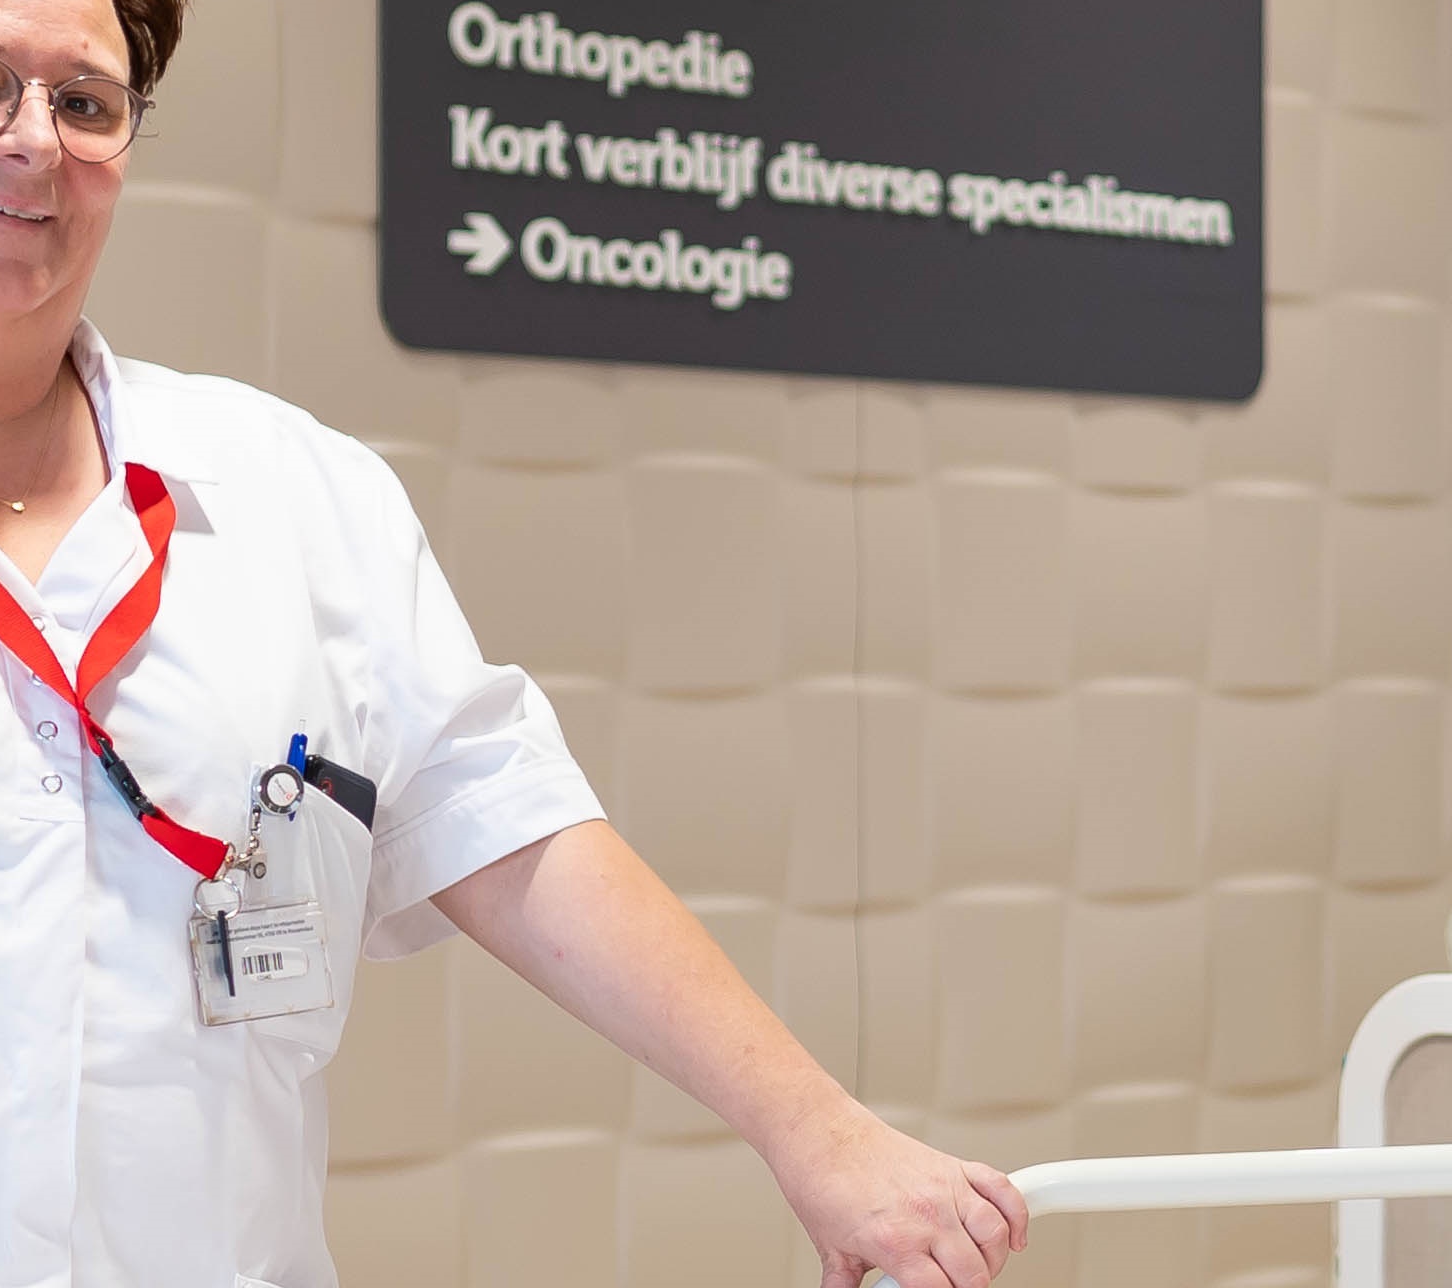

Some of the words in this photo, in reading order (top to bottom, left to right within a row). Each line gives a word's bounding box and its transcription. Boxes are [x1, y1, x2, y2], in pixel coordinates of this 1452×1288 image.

[448, 2, 753, 97] Orthopedie
[449, 108, 570, 179] Kort
[577, 128, 759, 208] verblijf
[767, 143, 941, 216] diverse
[948, 173, 1233, 247] specialismen
[520, 218, 792, 310] Oncologie
